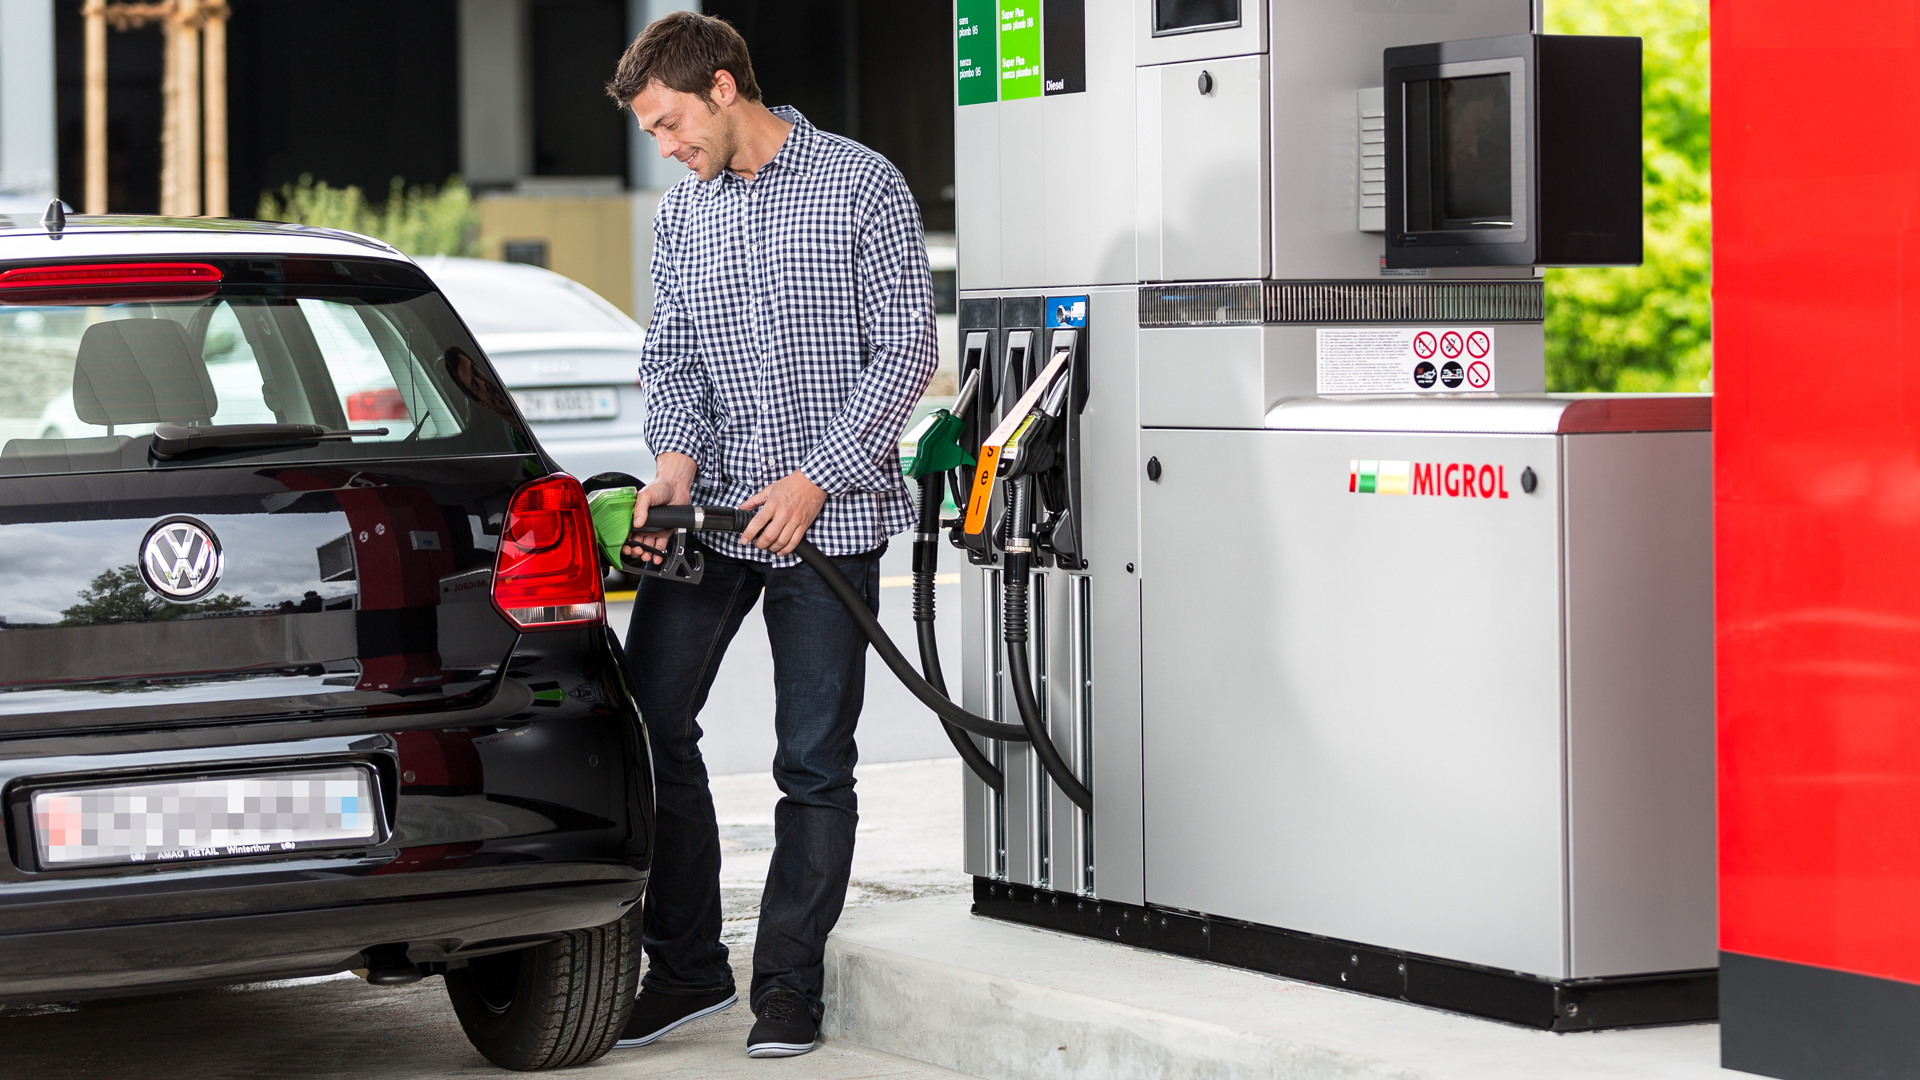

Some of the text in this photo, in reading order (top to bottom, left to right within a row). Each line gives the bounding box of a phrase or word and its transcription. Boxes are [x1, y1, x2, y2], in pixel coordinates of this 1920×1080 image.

[1002, 8, 1024, 20] Super Plus
[959, 17, 969, 25] sans
[1002, 22, 1012, 31] sans
[1027, 18, 1033, 27] 98
[972, 25, 978, 35] 95
[960, 58, 971, 67] senza
[1002, 56, 1025, 68] Super Plus
[975, 67, 981, 76] 95
[1002, 71, 1015, 79] senza
[1033, 66, 1039, 75] 98
[1046, 79, 1064, 91] Diesel
[1413, 463, 1509, 499] MIGROL
[158, 843, 270, 859] AMAG RETAIL Winterthur
